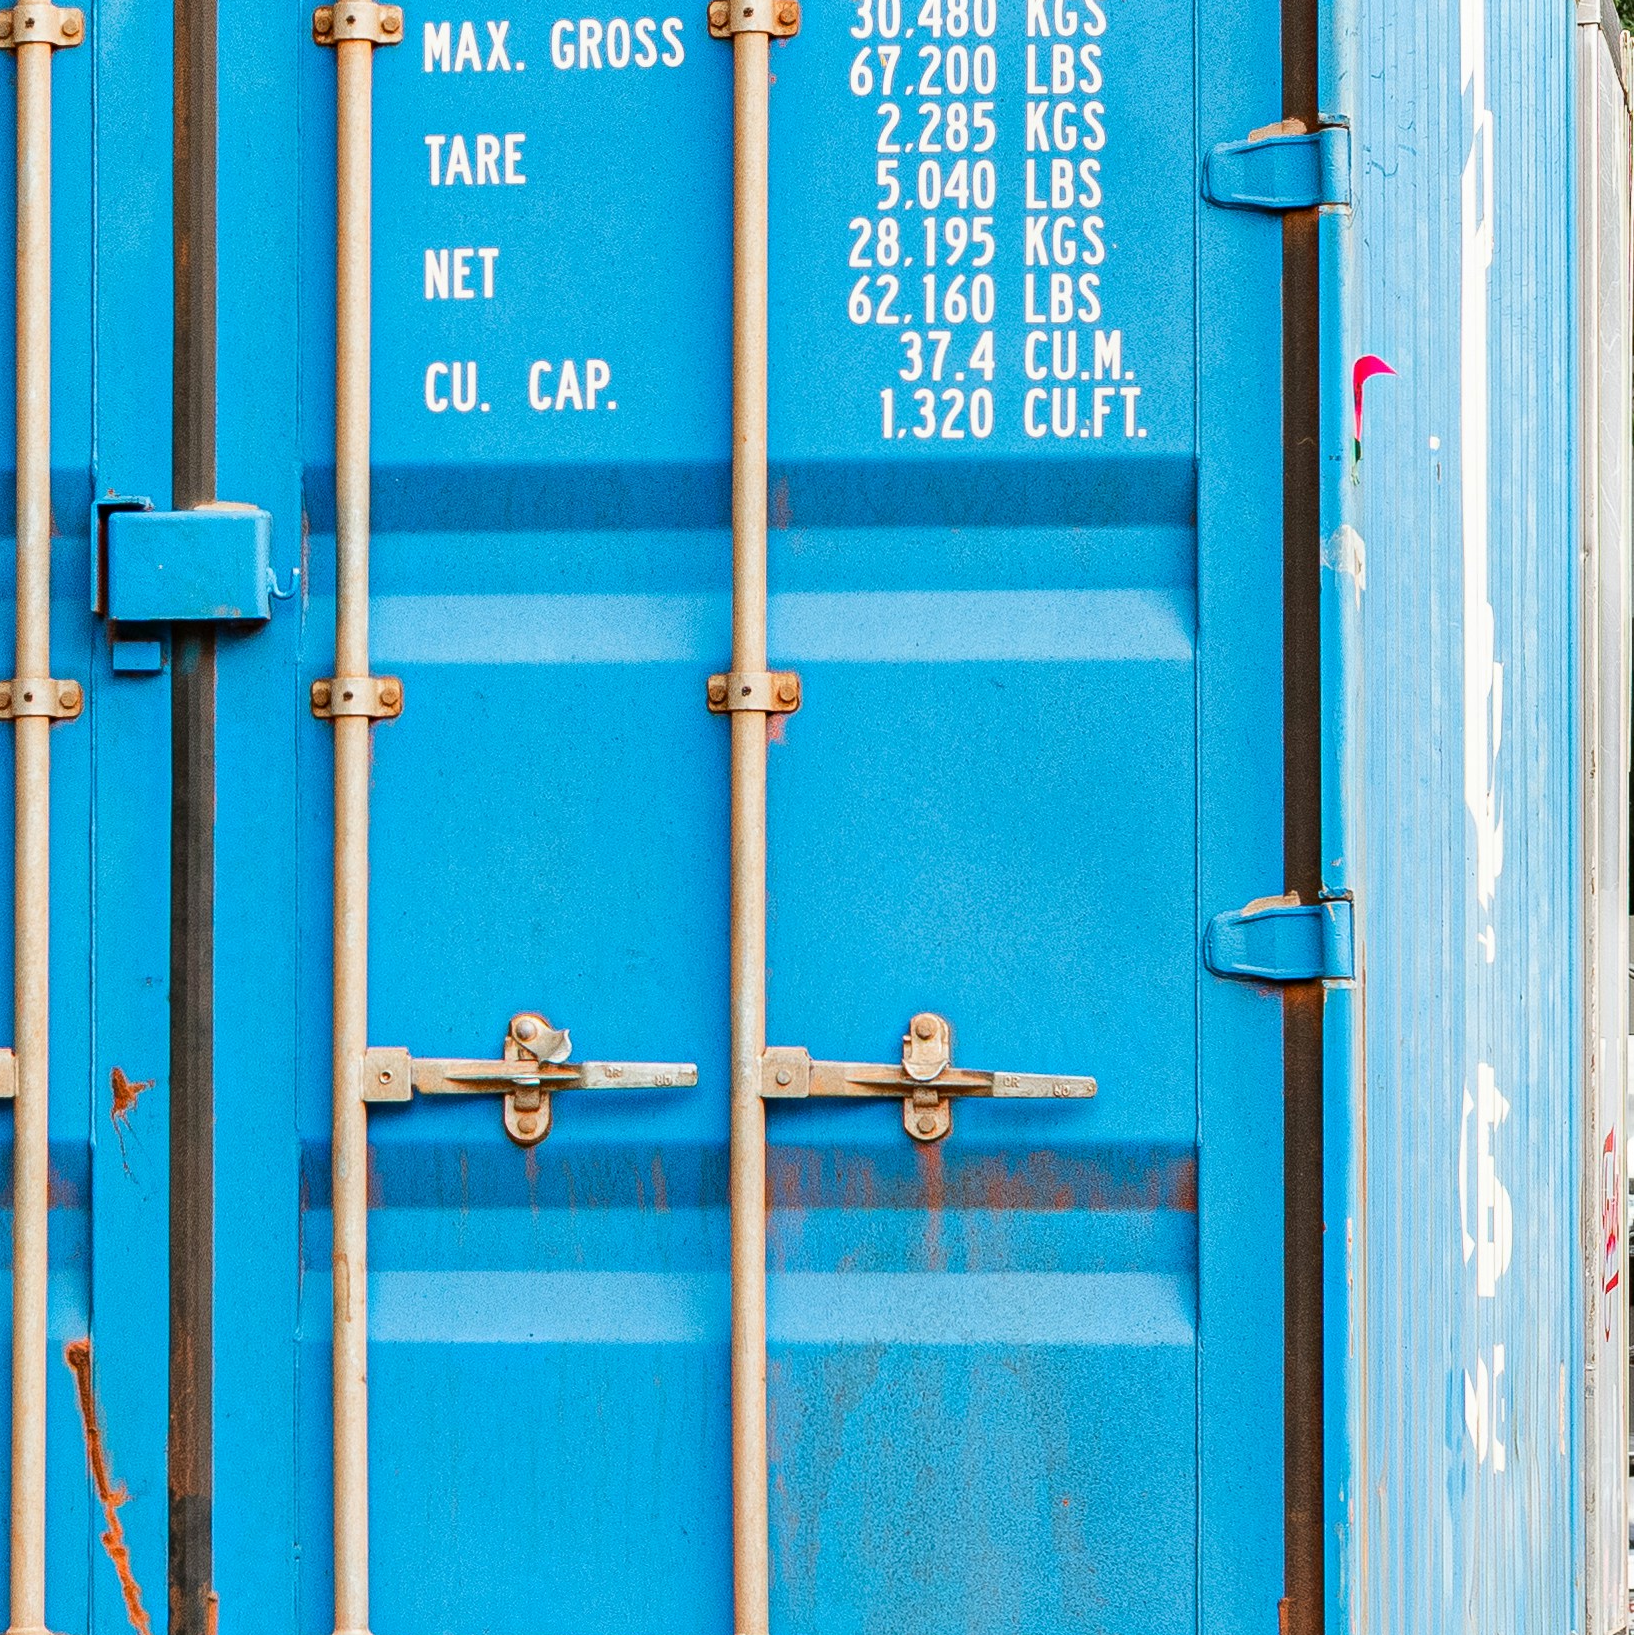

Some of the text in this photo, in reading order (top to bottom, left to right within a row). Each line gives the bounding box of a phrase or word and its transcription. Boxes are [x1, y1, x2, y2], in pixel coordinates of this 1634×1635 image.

[424, 17, 685, 72] MAX. GROSS
[850, 43, 1103, 96] 67,200 LBS
[877, 100, 1106, 153] 2,285 KGS
[424, 133, 526, 186] TARE
[877, 158, 1102, 210] 5,040 LBS
[848, 215, 1105, 268] 28,195 KGS
[424, 247, 499, 299] NET
[848, 272, 1101, 325] 62,160 LBS
[899, 330, 995, 381] 37.4
[425, 359, 617, 412] CU. CAP.
[880, 387, 994, 439] 1,320
